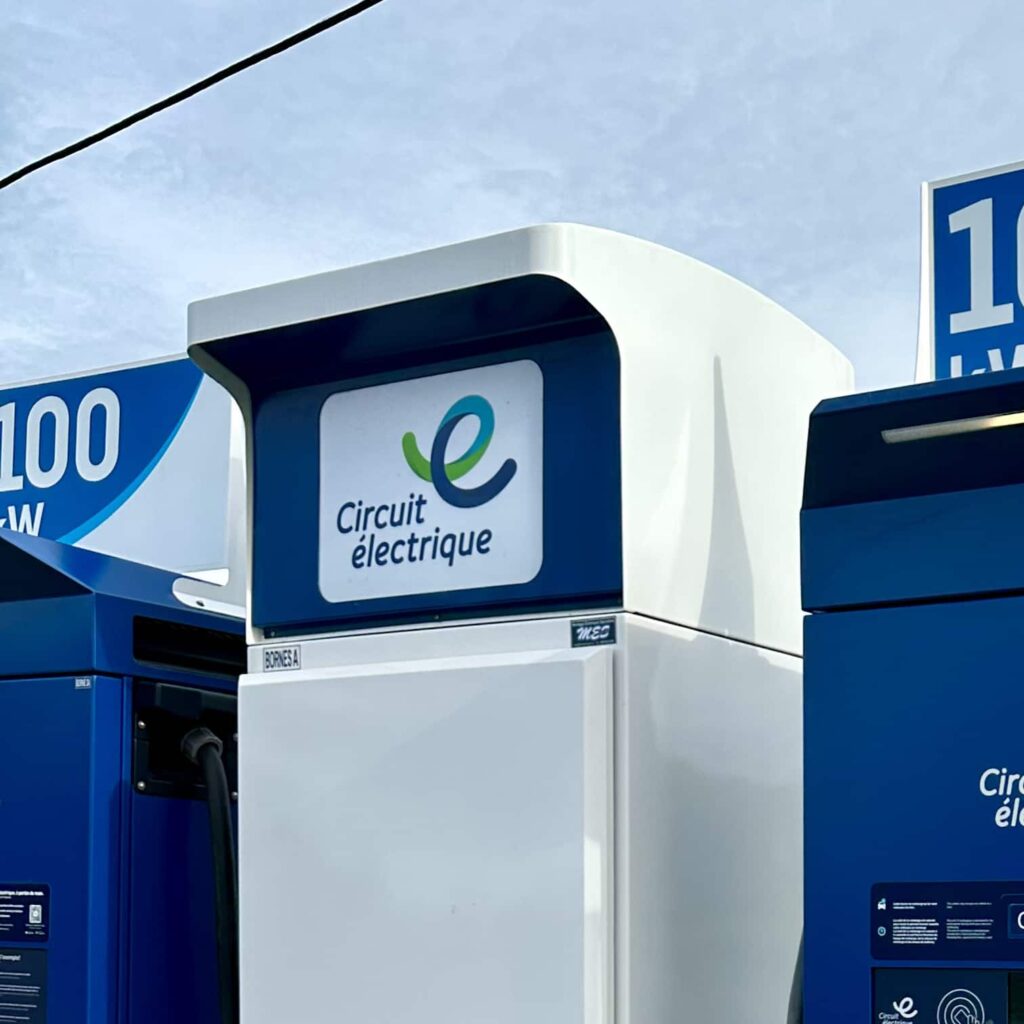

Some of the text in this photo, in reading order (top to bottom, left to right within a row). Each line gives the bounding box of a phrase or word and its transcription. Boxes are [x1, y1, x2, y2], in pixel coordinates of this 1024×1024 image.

[0, 387, 121, 492] 100
[0, 502, 45, 537] W
[336, 493, 427, 535] Circuit
[350, 526, 493, 570] électrique
[265, 649, 299, 669] BORNES A
[878, 1012, 900, 1020] Circuit
